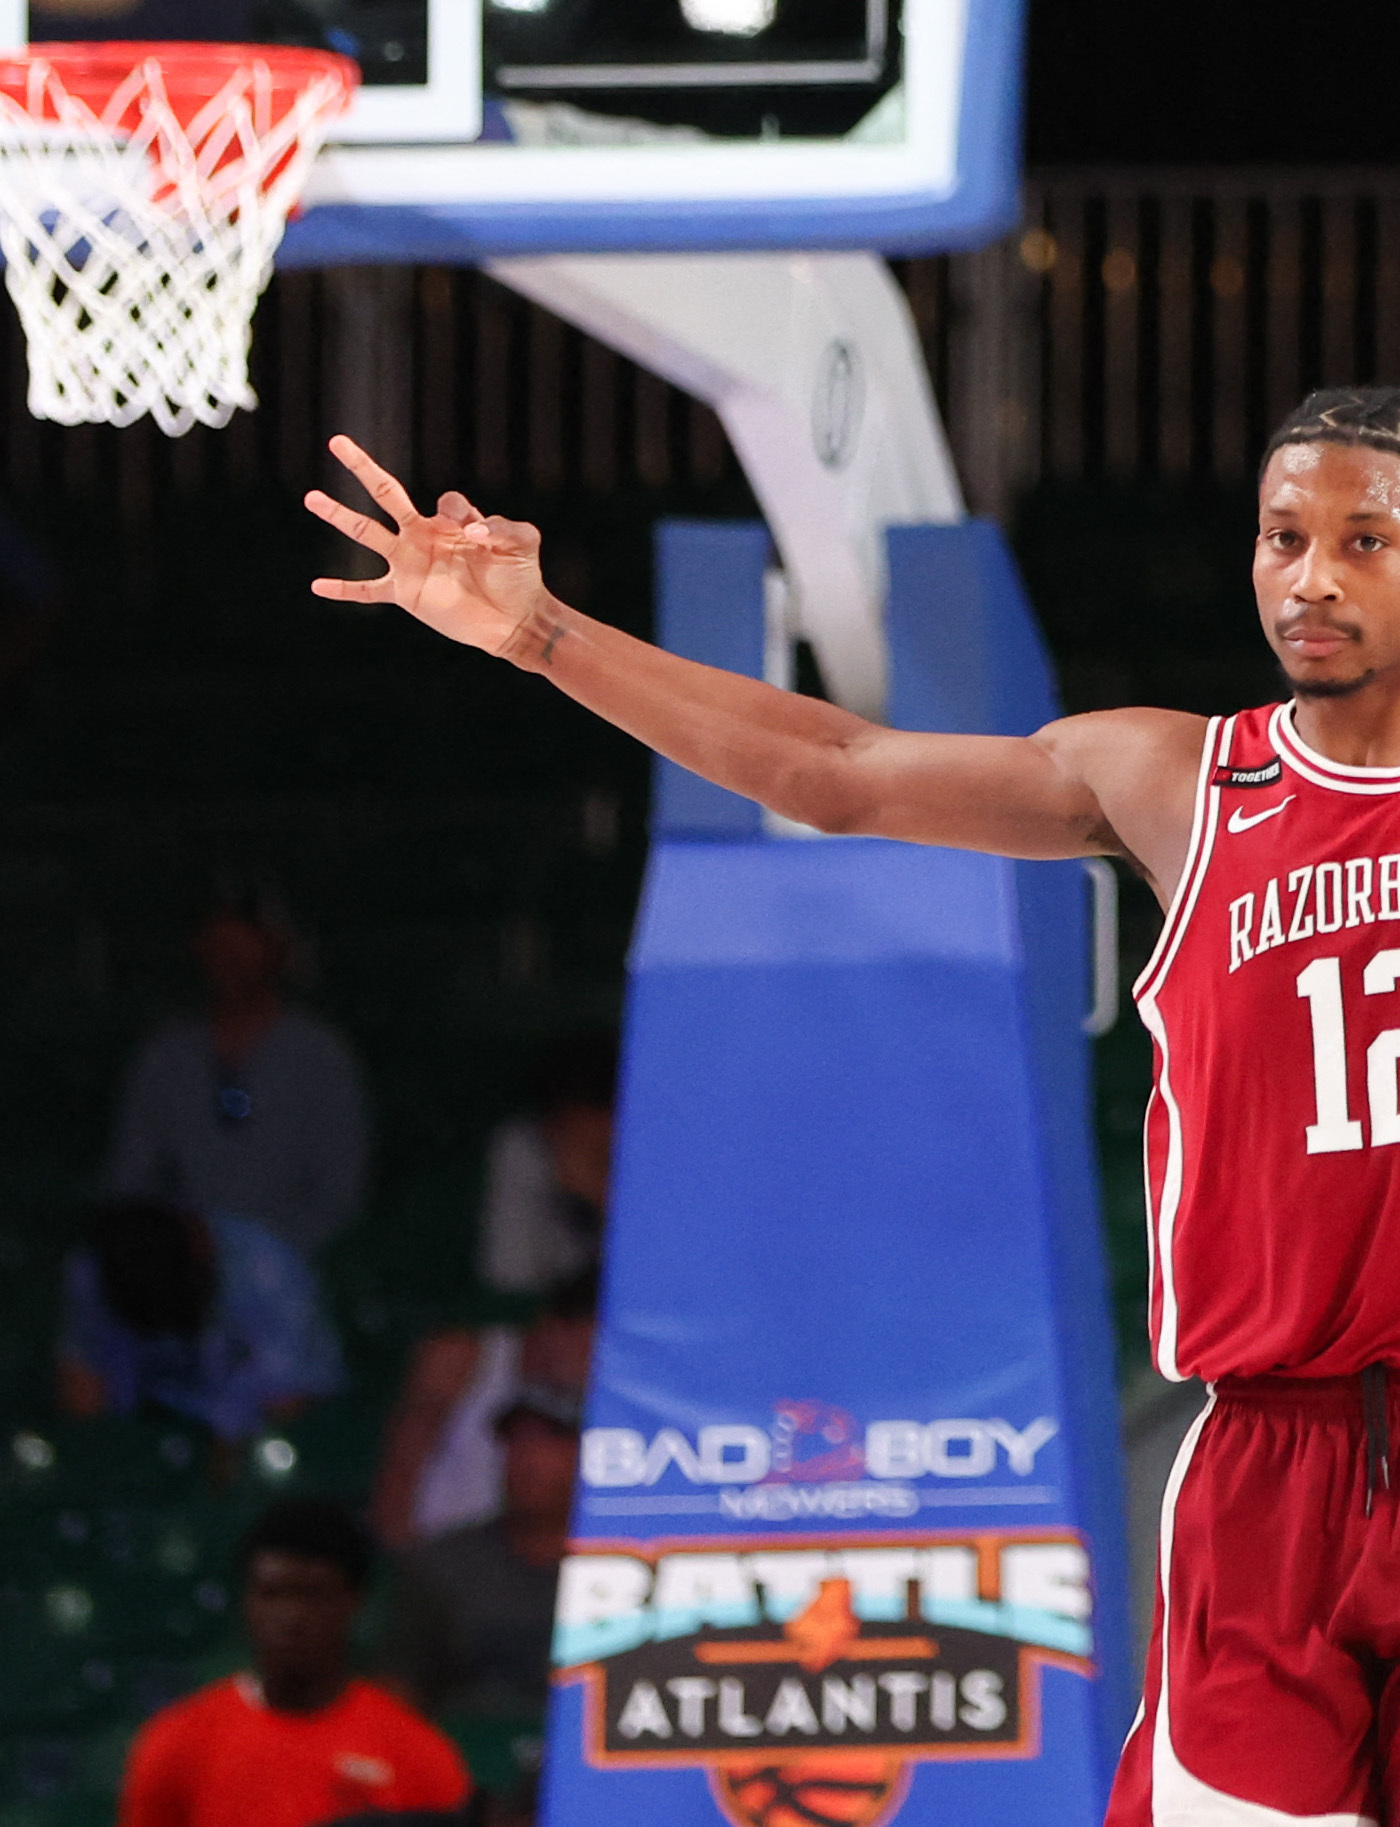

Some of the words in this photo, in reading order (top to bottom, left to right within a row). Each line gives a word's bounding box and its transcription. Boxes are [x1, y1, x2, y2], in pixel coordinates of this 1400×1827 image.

[580, 1423, 773, 1488] BAD
[864, 1416, 1060, 1480] BOY
[550, 1543, 1094, 1668] BATTLE
[616, 1670, 1008, 1740] ATLANTIS
